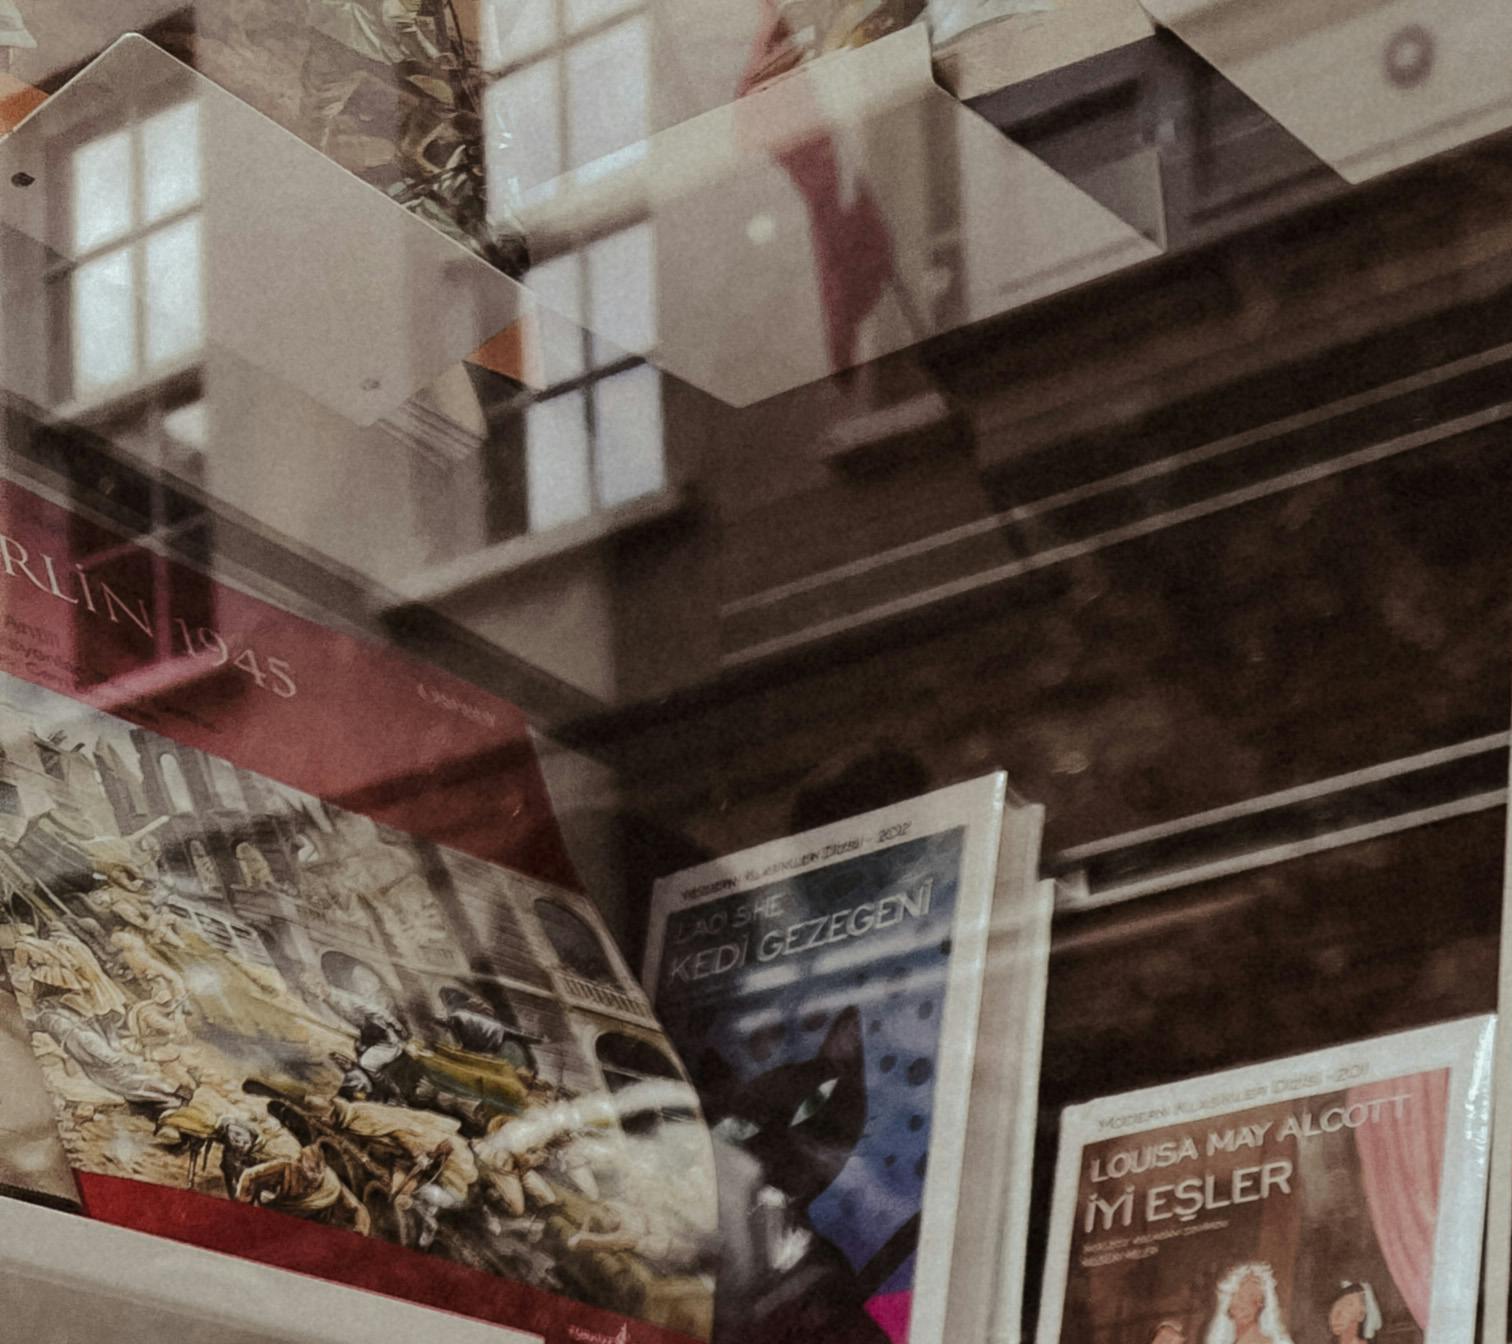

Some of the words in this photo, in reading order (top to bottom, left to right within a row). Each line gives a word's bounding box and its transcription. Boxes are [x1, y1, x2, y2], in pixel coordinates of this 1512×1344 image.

[175, 617, 297, 698] 1945
[668, 934, 750, 985] KEDİ
[756, 877, 934, 963] GEZEGENİ
[731, 892, 785, 929] SHE
[1090, 1135, 1199, 1183] LOUISA
[1206, 1121, 1273, 1157] MAY
[1276, 1094, 1412, 1142] ALCOTT
[1084, 1184, 1136, 1234] İYİ
[1145, 1159, 1294, 1222] EŞLER
